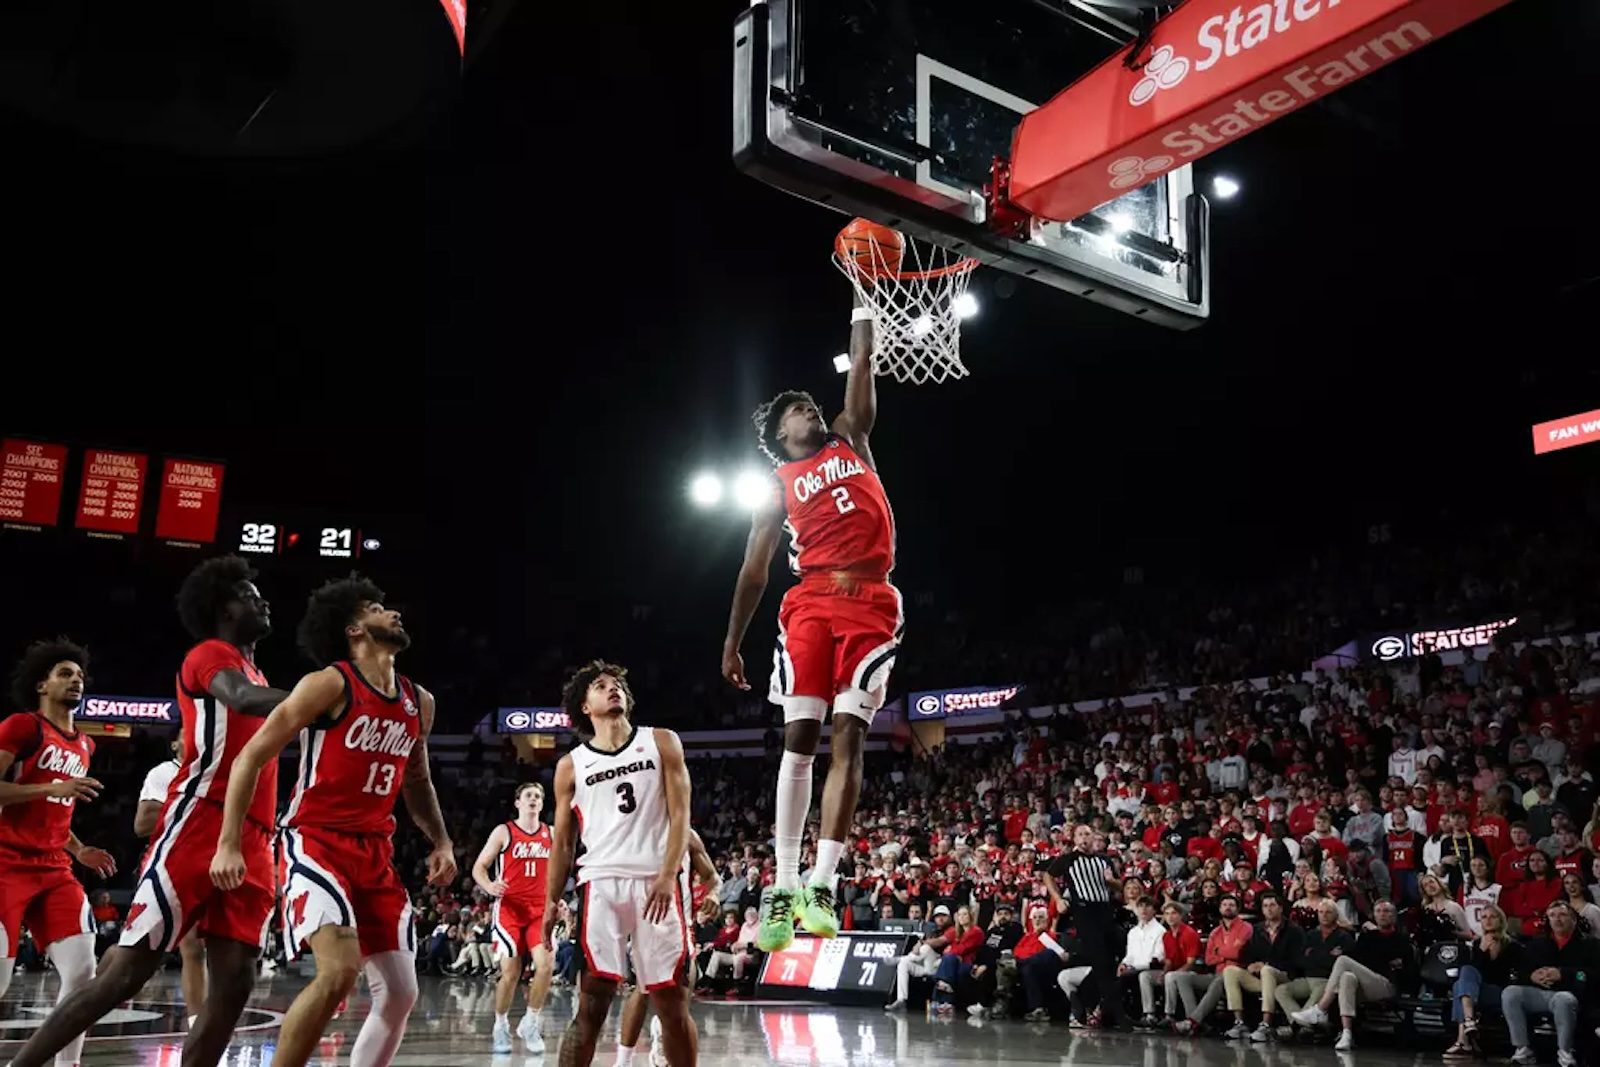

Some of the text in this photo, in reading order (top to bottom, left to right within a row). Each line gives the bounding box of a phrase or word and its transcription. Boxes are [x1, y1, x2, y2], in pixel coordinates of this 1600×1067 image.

[1549, 424, 1579, 442] FAN
[26, 445, 43, 456] SEC
[95, 453, 136, 468] NATIONAL
[6, 454, 59, 470] CHAMPIONS
[89, 464, 139, 479] CHAMPIONS
[173, 463, 213, 477] NATIONAL
[3, 469, 27, 479] 2001
[168, 473, 217, 489] CHAMPIONS
[793, 455, 866, 502] Ole Miss
[831, 486, 856, 514] 2
[111, 510, 135, 519] 2007
[241, 523, 276, 544] 32
[320, 528, 352, 548] 21
[1411, 617, 1518, 656] SEATGE
[85, 699, 172, 720] SEATGEEK
[345, 714, 381, 752] Ole
[37, 744, 64, 772] Ole
[362, 761, 396, 796] 13
[585, 759, 656, 786] GEORGIA
[616, 782, 637, 814] 3
[512, 841, 529, 858] Ole
[524, 861, 537, 877] 11
[853, 942, 873, 957] OLE
[780, 959, 799, 981] 71
[858, 961, 879, 985] 71
